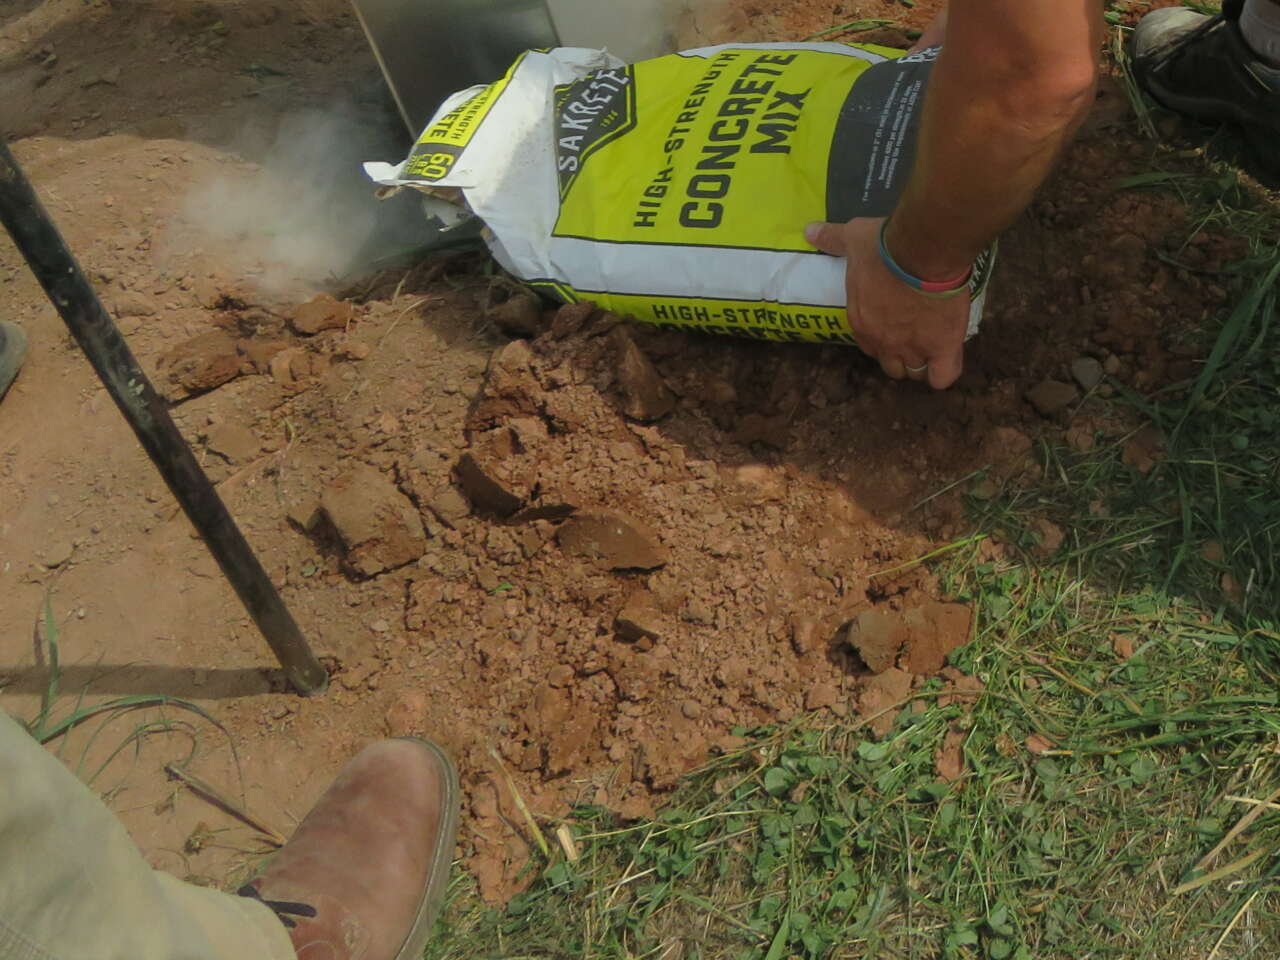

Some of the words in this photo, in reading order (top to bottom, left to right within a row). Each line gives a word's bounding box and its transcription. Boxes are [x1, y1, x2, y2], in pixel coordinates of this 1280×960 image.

[559, 69, 629, 171] SAKRETE
[633, 53, 740, 227] HIGH-STRENGTH
[679, 54, 799, 228] CONCRETE
[749, 88, 812, 154] MIX
[421, 152, 454, 178] 60
[652, 304, 842, 330] HIGH-STRENGTH
